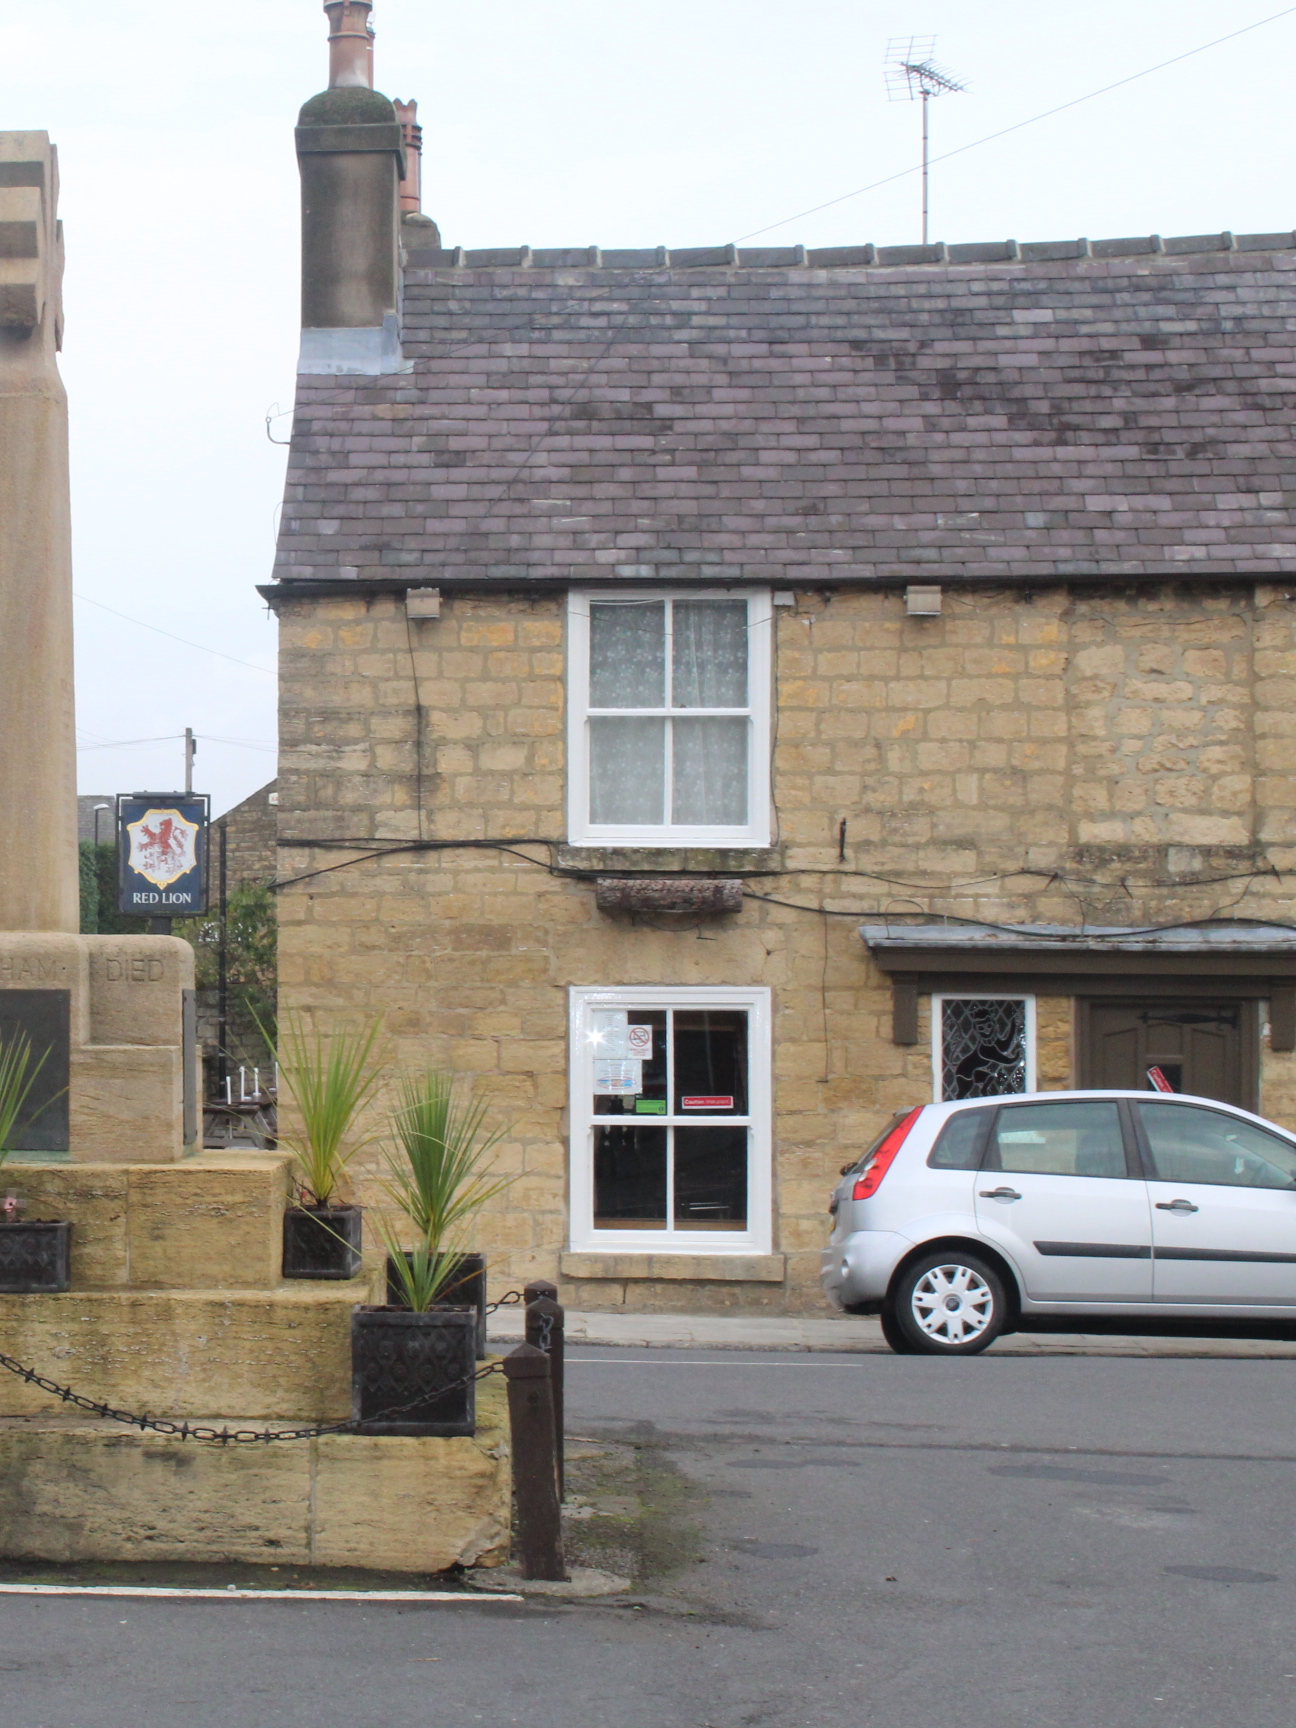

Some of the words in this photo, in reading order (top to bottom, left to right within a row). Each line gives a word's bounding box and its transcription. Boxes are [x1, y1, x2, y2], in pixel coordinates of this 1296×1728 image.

[133, 892, 159, 904] RED
[162, 892, 192, 904] LION
[106, 958, 165, 982] DIED
